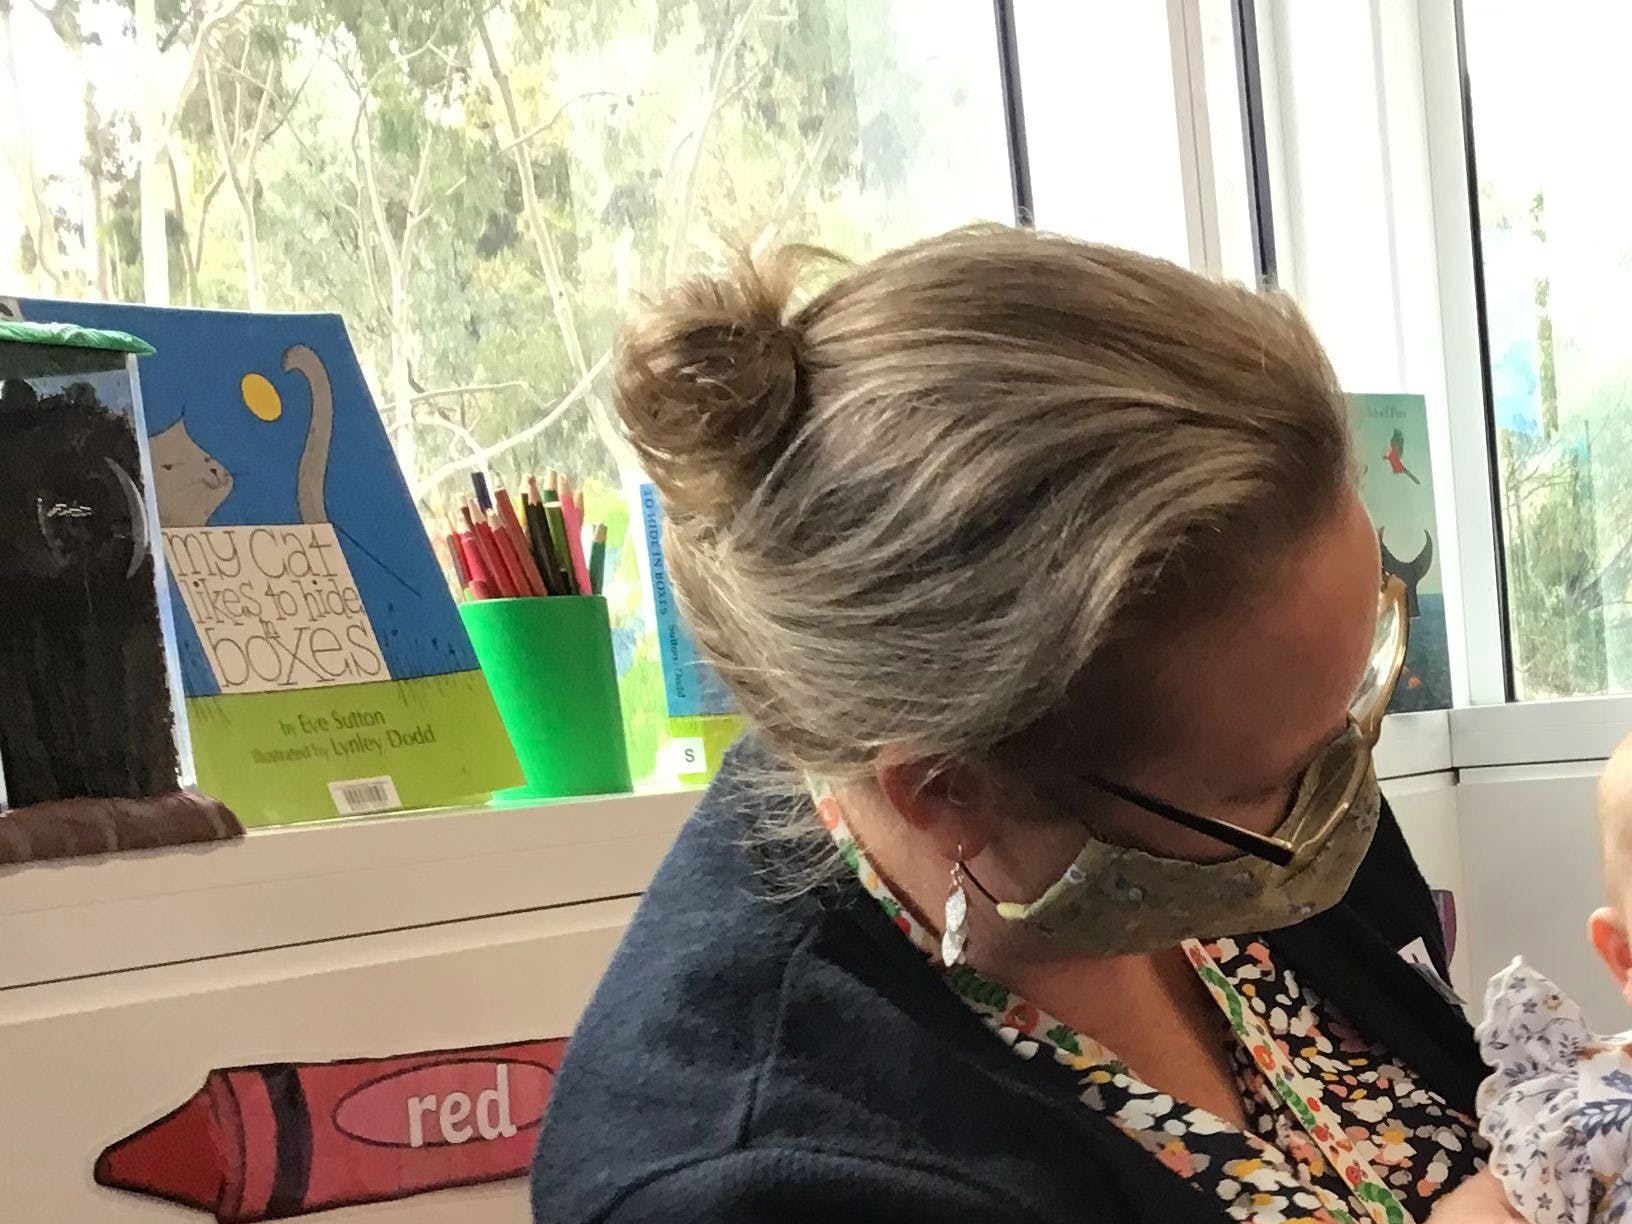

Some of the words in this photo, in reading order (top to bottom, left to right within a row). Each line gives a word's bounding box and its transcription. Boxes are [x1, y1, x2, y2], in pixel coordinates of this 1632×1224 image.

[161, 530, 241, 580] my
[180, 578, 263, 626] likes
[264, 581, 298, 621] to
[292, 578, 364, 622] hide
[205, 620, 381, 688] boxes
[297, 713, 329, 734] Eve
[331, 710, 386, 730] Sutton
[330, 732, 384, 757] Lynley
[386, 723, 437, 748] Dodd
[684, 748, 696, 763] S
[406, 1063, 517, 1148] red
